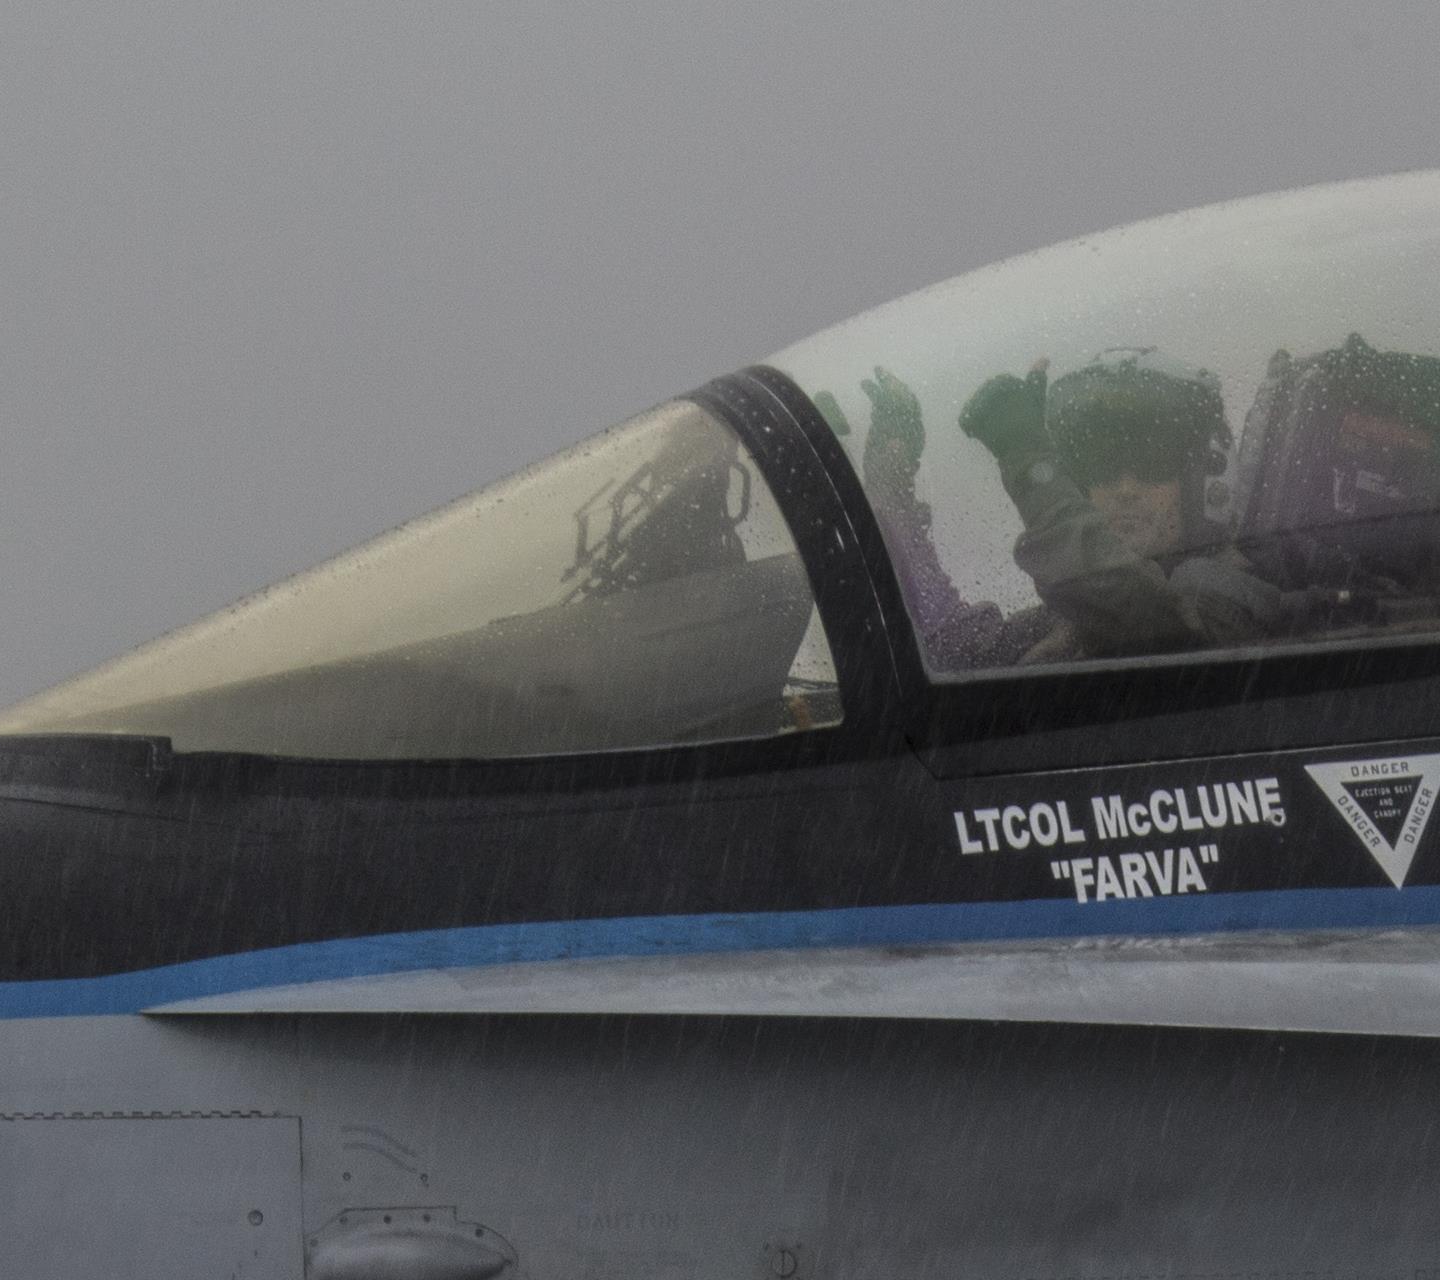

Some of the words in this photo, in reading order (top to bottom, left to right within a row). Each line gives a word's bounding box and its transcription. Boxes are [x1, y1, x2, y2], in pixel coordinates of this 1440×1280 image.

[1350, 762, 1409, 777] DANGER
[954, 800, 1085, 855] LTCOL
[1091, 777, 1281, 840] McCLUNE
[1338, 795, 1381, 848] DANGER
[1404, 788, 1433, 844] DANGER
[1050, 844, 1219, 904] "FARVA"
